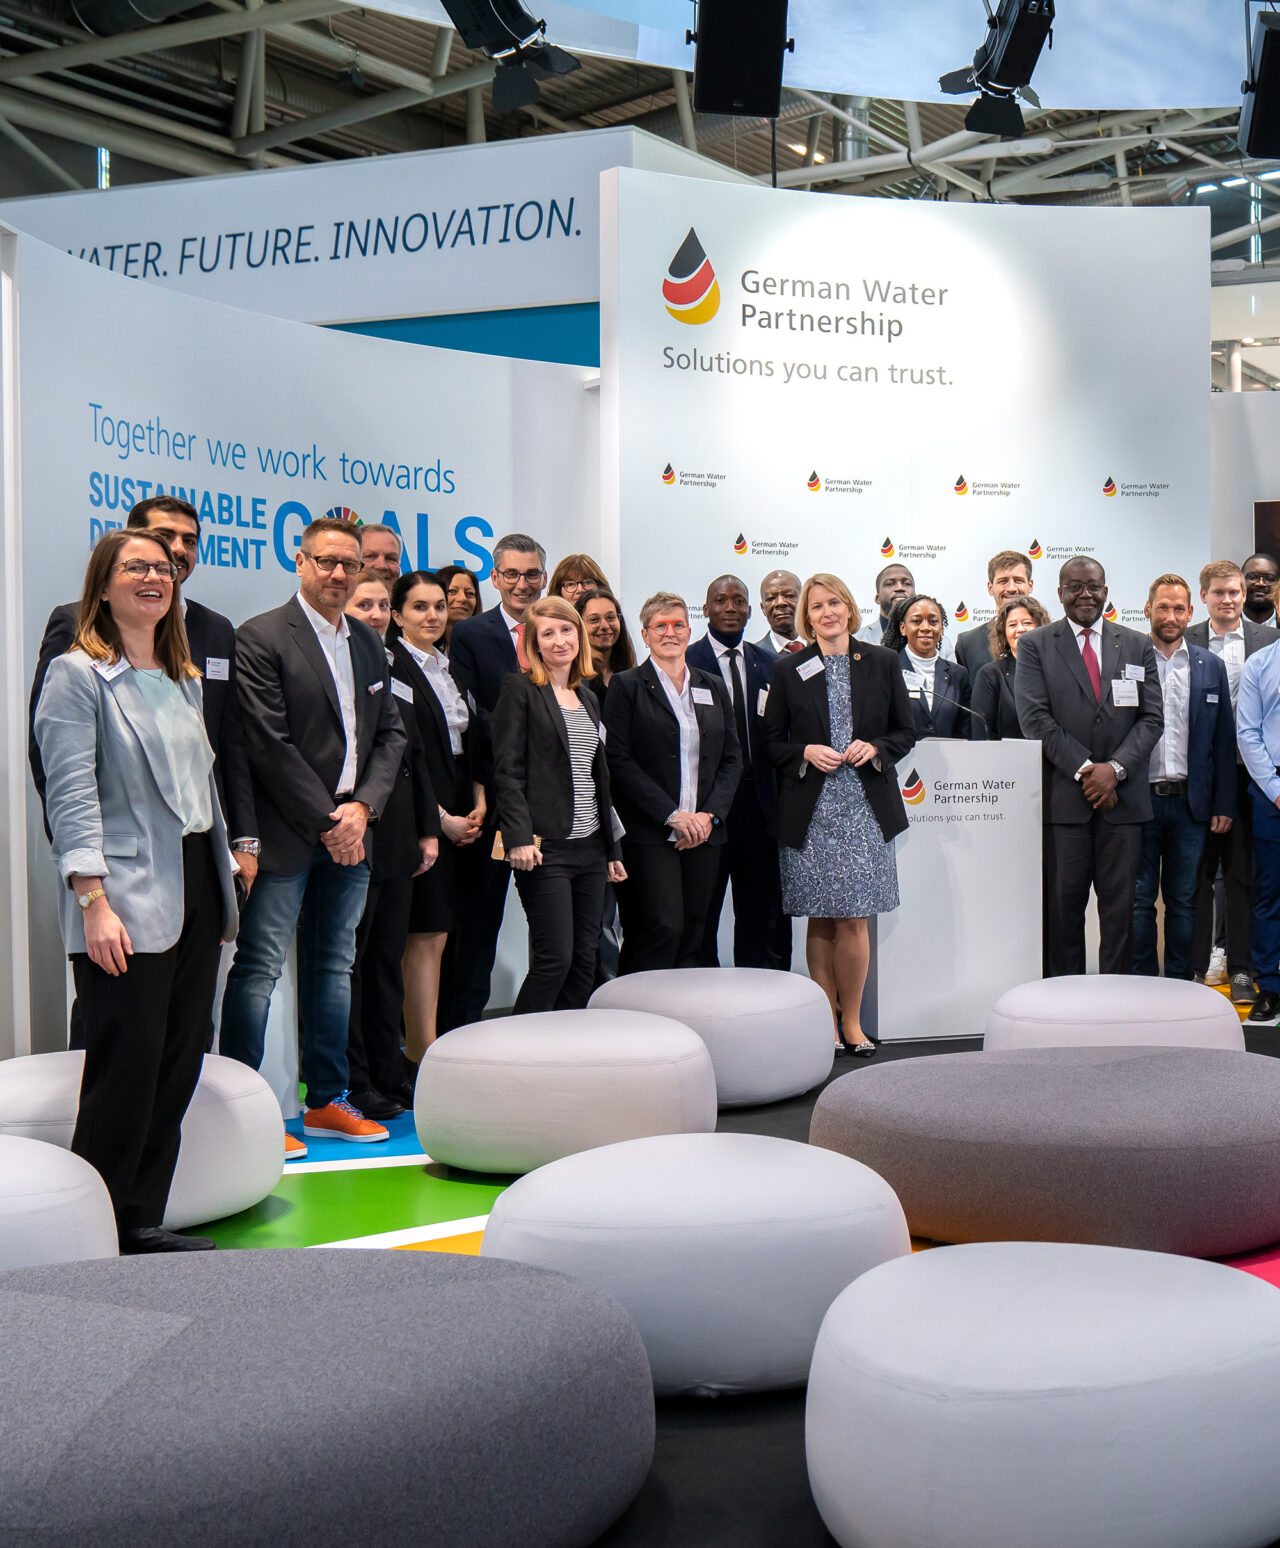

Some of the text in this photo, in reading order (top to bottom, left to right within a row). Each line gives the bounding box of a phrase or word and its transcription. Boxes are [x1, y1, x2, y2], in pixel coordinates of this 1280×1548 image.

[179, 224, 319, 276] FUTURE.
[329, 196, 582, 261] INNOVATION.
[741, 269, 949, 306] German Water
[741, 303, 904, 343] Partnership
[662, 346, 954, 386] Solutions you can trust.
[88, 401, 456, 494] Together we work towards
[679, 471, 727, 480] German Water
[679, 478, 717, 488] Partnership
[824, 478, 851, 486] German
[972, 481, 999, 489] German
[1149, 482, 1170, 490] Water
[824, 485, 864, 494] Partnership
[972, 489, 1011, 497] Partnership
[1120, 490, 1160, 498] Partnership
[751, 540, 799, 549] German Water
[751, 548, 790, 557] Partnership
[898, 551, 937, 560] Partnership
[934, 780, 1016, 791] German Water
[934, 792, 999, 805] Partnership
[908, 812, 1006, 824] olutions you can trust.
